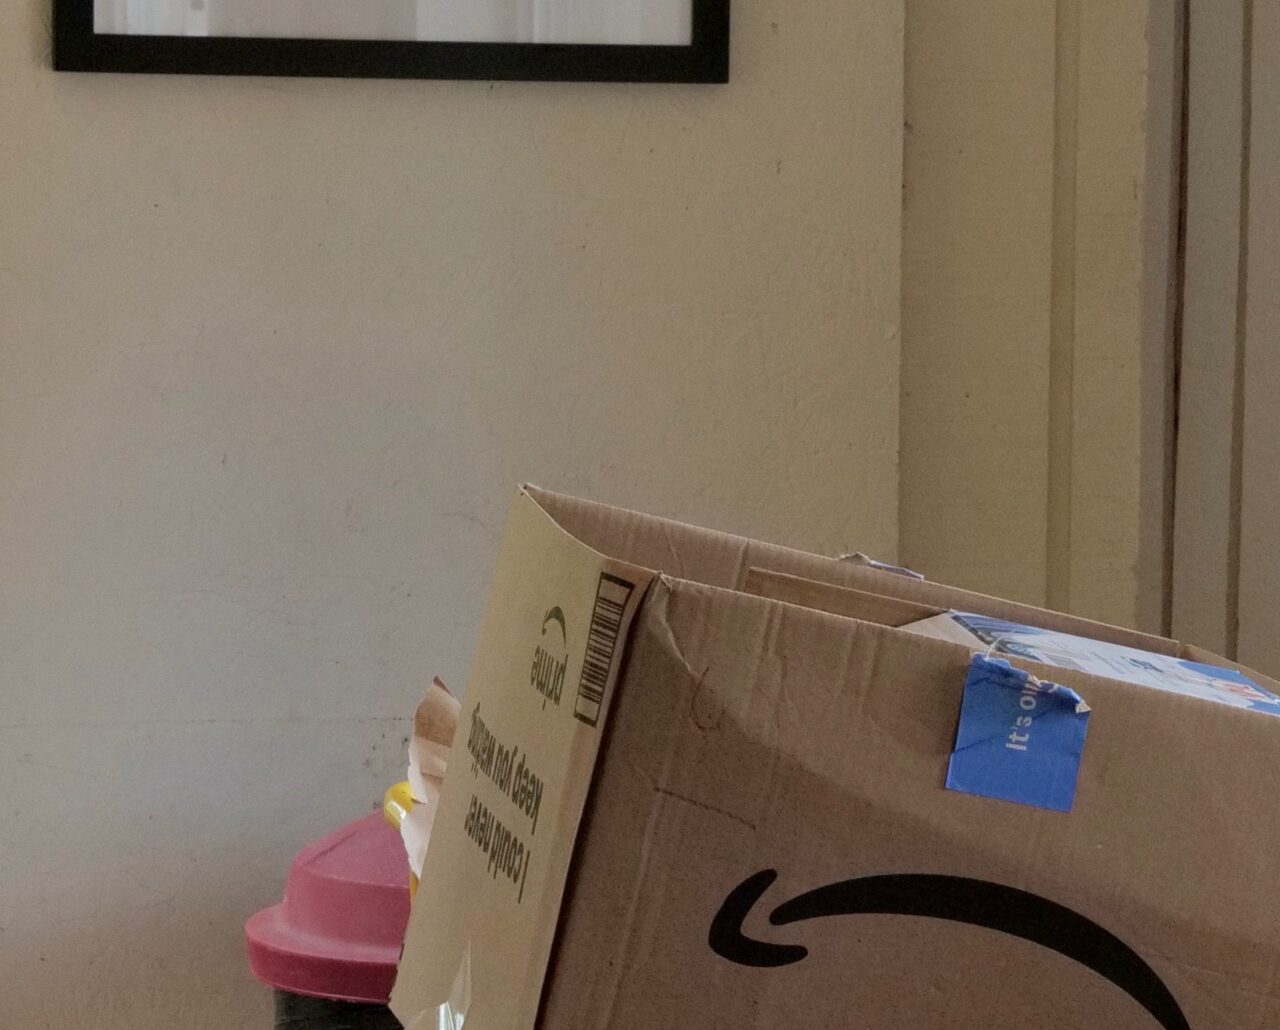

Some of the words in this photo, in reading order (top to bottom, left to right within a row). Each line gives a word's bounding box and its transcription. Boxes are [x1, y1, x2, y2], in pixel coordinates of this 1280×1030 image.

[530, 645, 569, 711] prime
[1005, 716, 1032, 751] It's
[493, 743, 518, 797] you
[512, 753, 544, 836] keep
[464, 794, 495, 853] never
[488, 820, 524, 884] could
